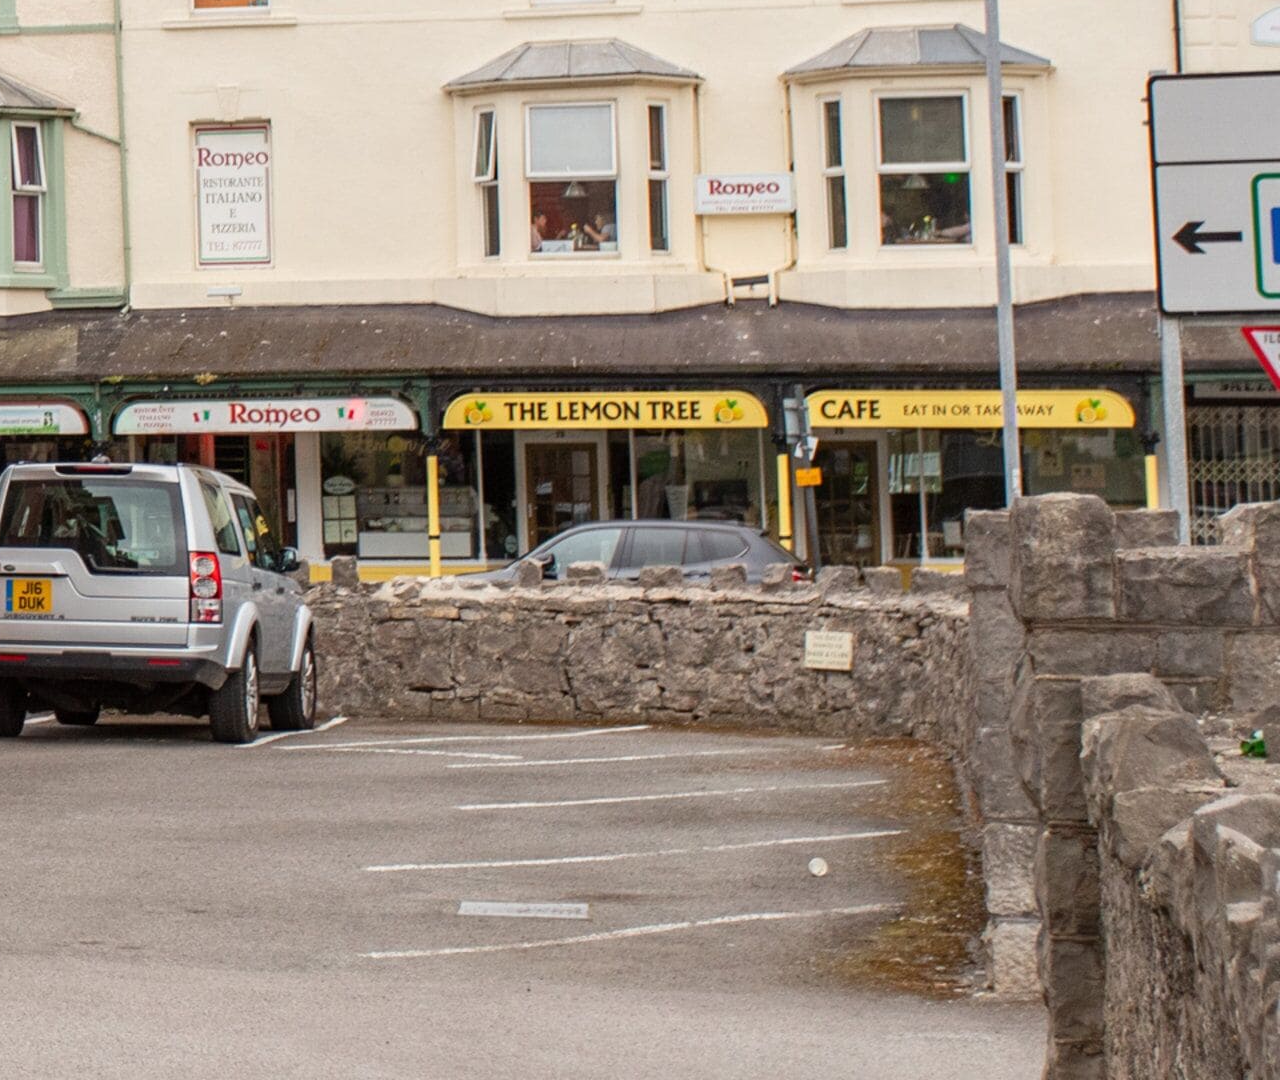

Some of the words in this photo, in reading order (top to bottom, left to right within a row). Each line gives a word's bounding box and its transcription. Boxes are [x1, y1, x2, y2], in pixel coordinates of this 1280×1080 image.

[197, 147, 269, 169] Romeo
[202, 176, 264, 189] RISTORANTE
[708, 179, 780, 197] Romeo
[205, 191, 263, 204] ITALIANO
[229, 208, 237, 218] E
[211, 223, 257, 234] PIZZERIA
[228, 402, 321, 428] Romeo
[503, 402, 549, 421] THE
[556, 402, 640, 421] LEMON
[646, 401, 702, 421] TREE
[821, 400, 881, 420] CAFE
[903, 404, 928, 416] EAT
[931, 404, 947, 416] IN
[951, 404, 970, 416] OR
[21, 582, 42, 595] J16
[18, 597, 45, 610] DUK
